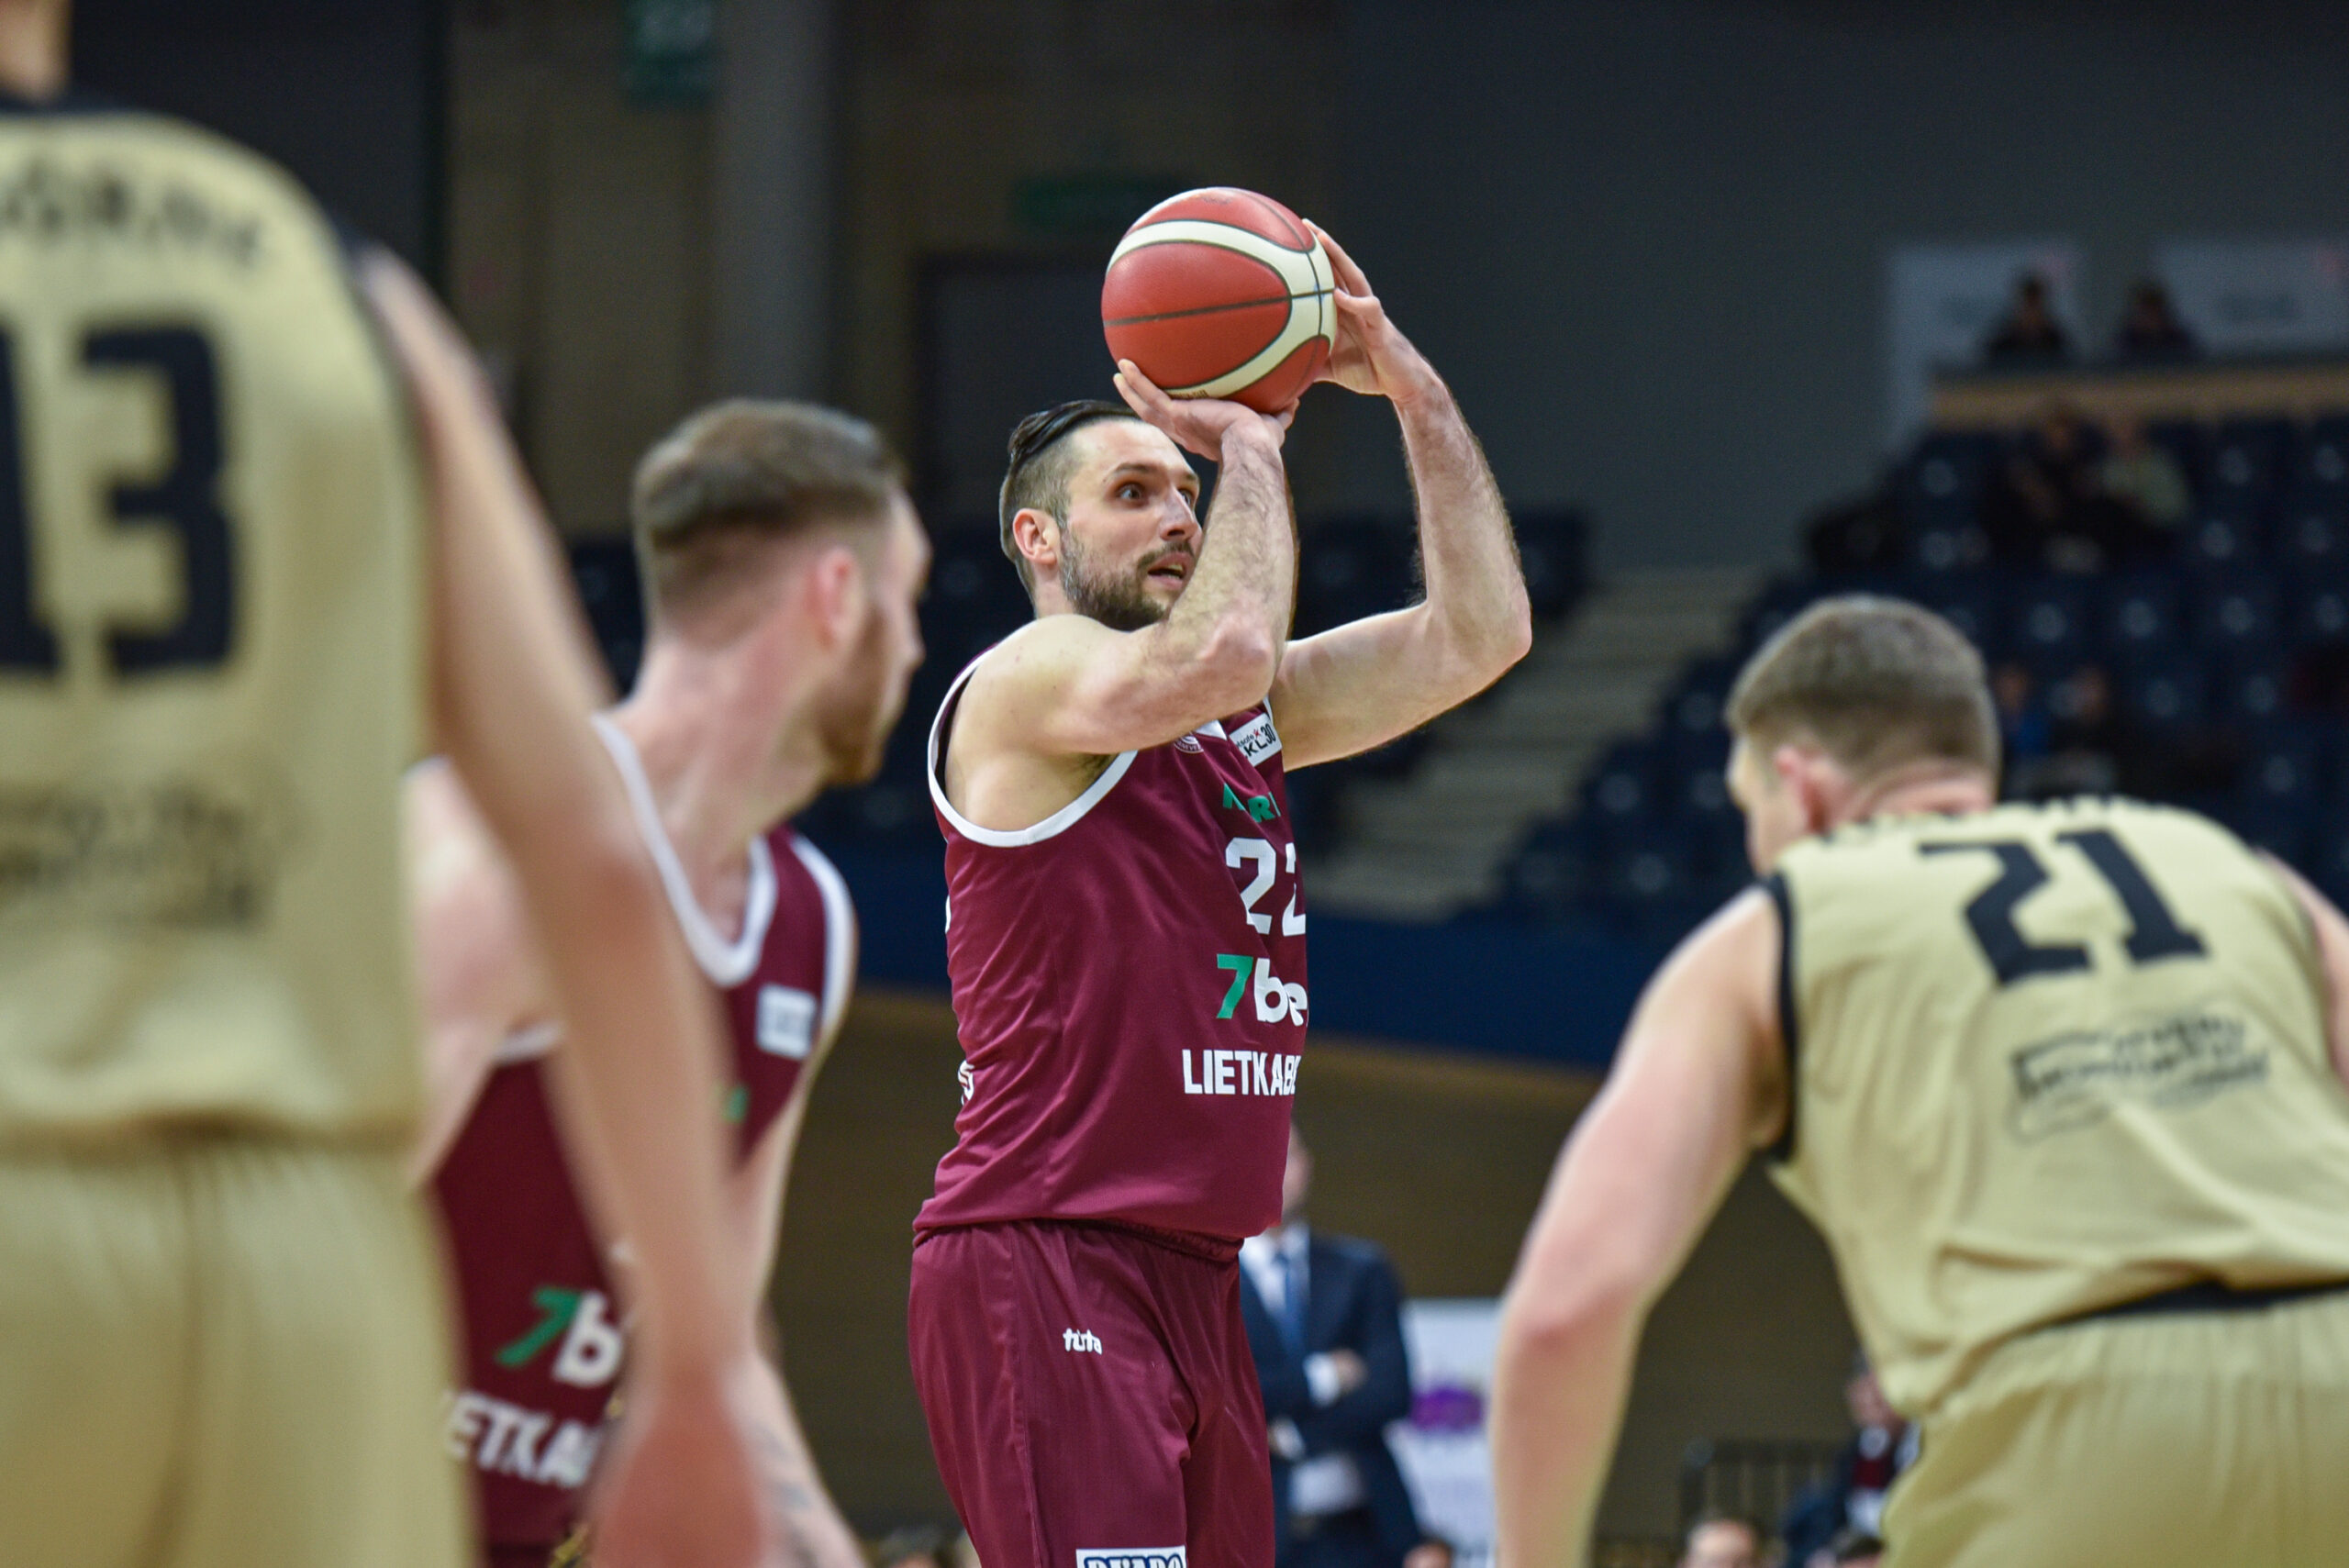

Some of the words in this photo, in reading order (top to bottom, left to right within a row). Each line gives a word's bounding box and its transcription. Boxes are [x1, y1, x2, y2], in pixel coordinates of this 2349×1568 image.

[1243, 740, 1268, 758] KL
[1226, 837, 1306, 937] 22
[1917, 828, 2210, 986] 21
